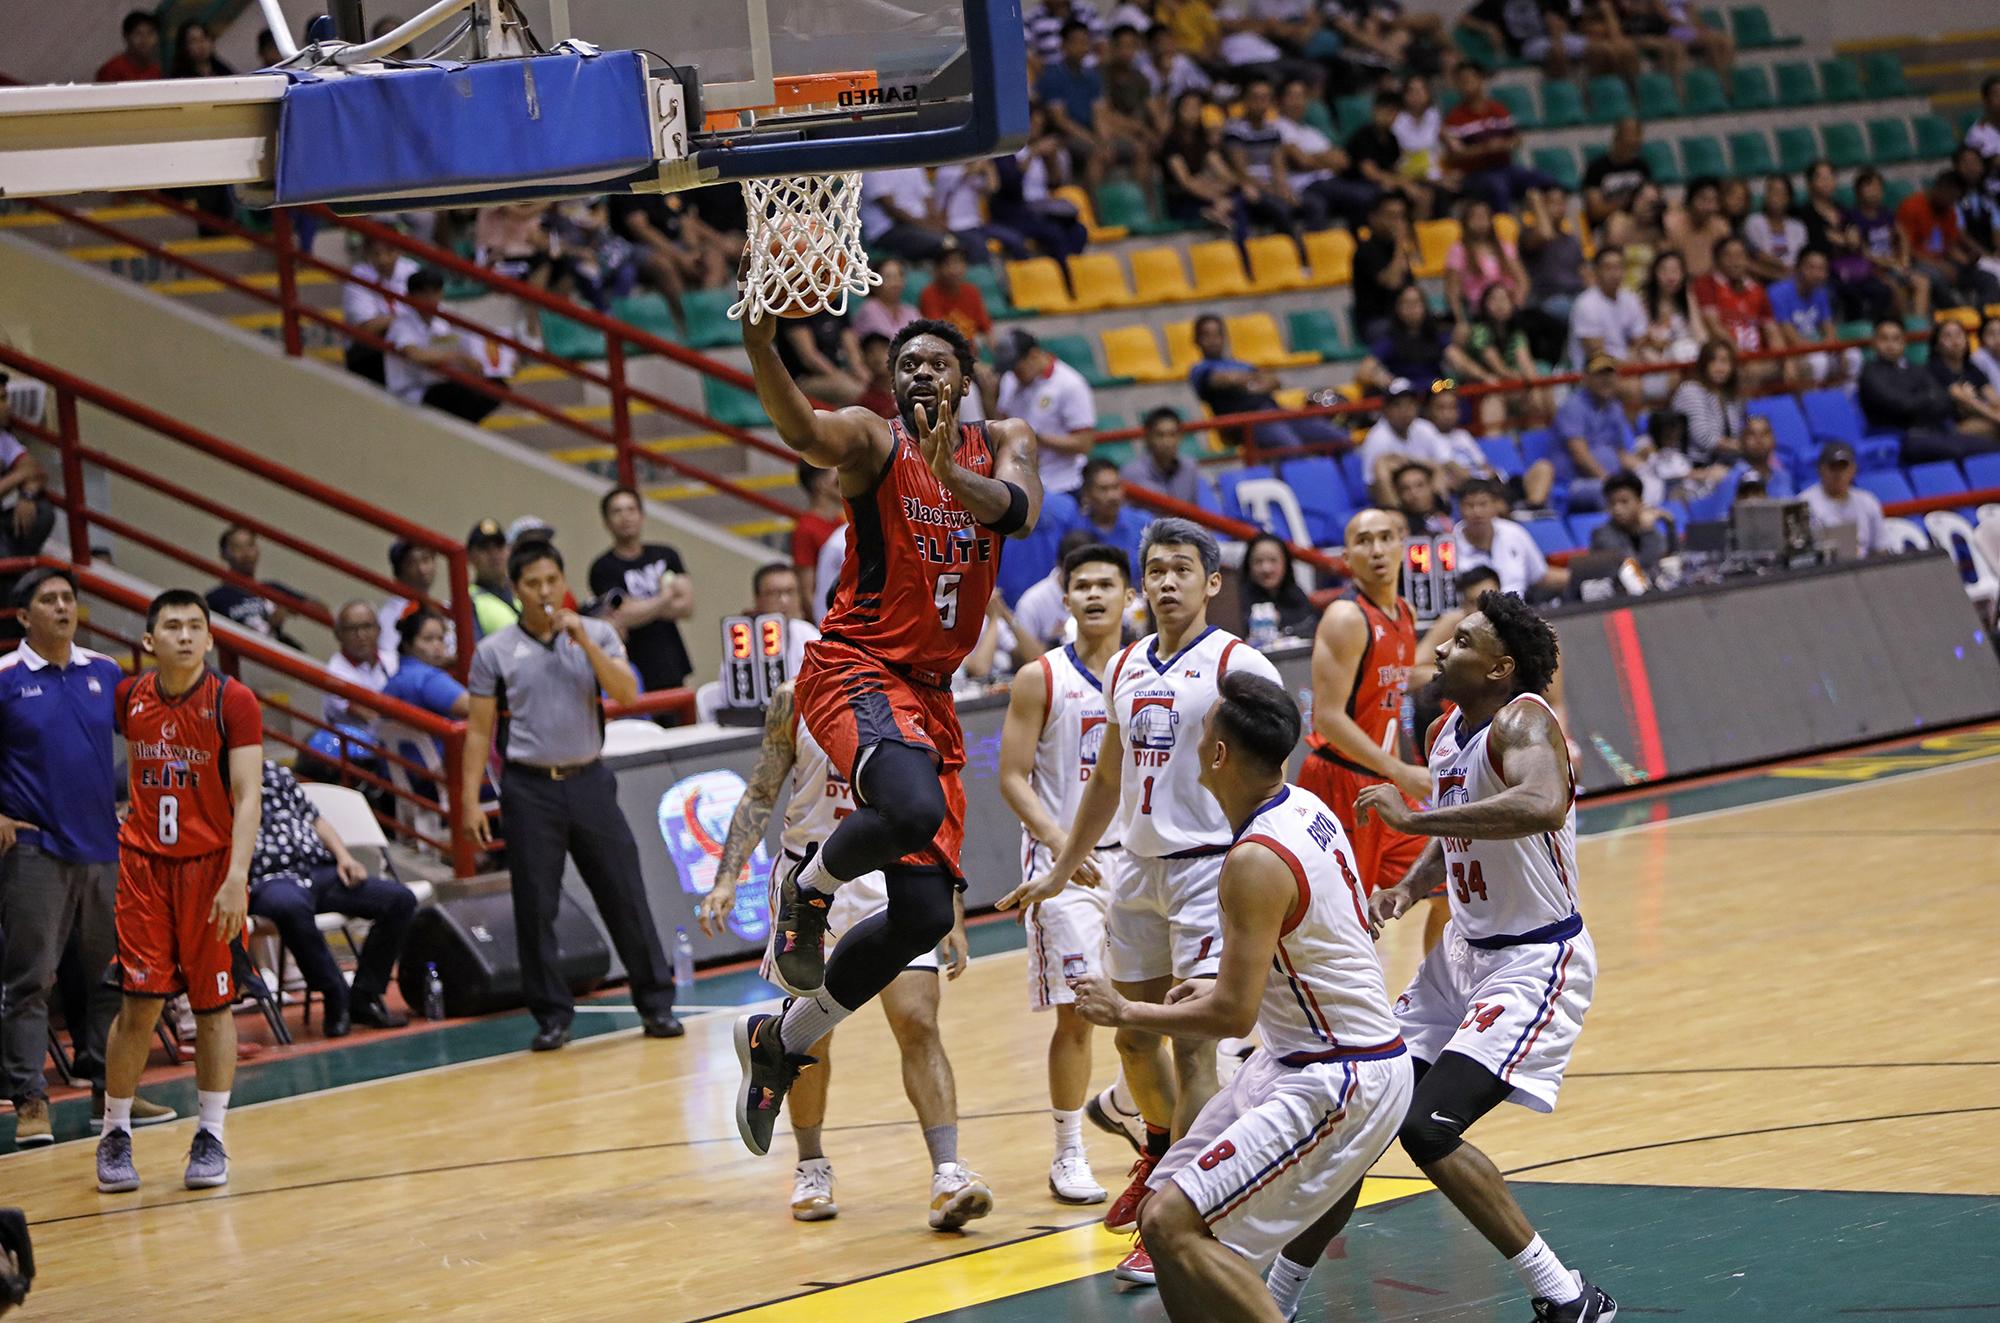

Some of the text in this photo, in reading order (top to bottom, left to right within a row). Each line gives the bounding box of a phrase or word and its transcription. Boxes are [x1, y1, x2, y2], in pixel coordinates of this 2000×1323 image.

[912, 533, 992, 564] ELITE
[1408, 544, 1432, 574] 4
[935, 572, 963, 630] 5
[733, 621, 781, 659] 3 3
[1134, 690, 1176, 698] COLUMBIAN
[1134, 750, 1171, 768] DYIP
[141, 764, 200, 791] ELITE
[1141, 775, 1155, 815] 1
[158, 794, 179, 846] 8
[1452, 860, 1488, 904] 34
[1193, 936, 1214, 961] 1
[216, 970, 229, 997] 8
[1197, 1139, 1236, 1171] 8
